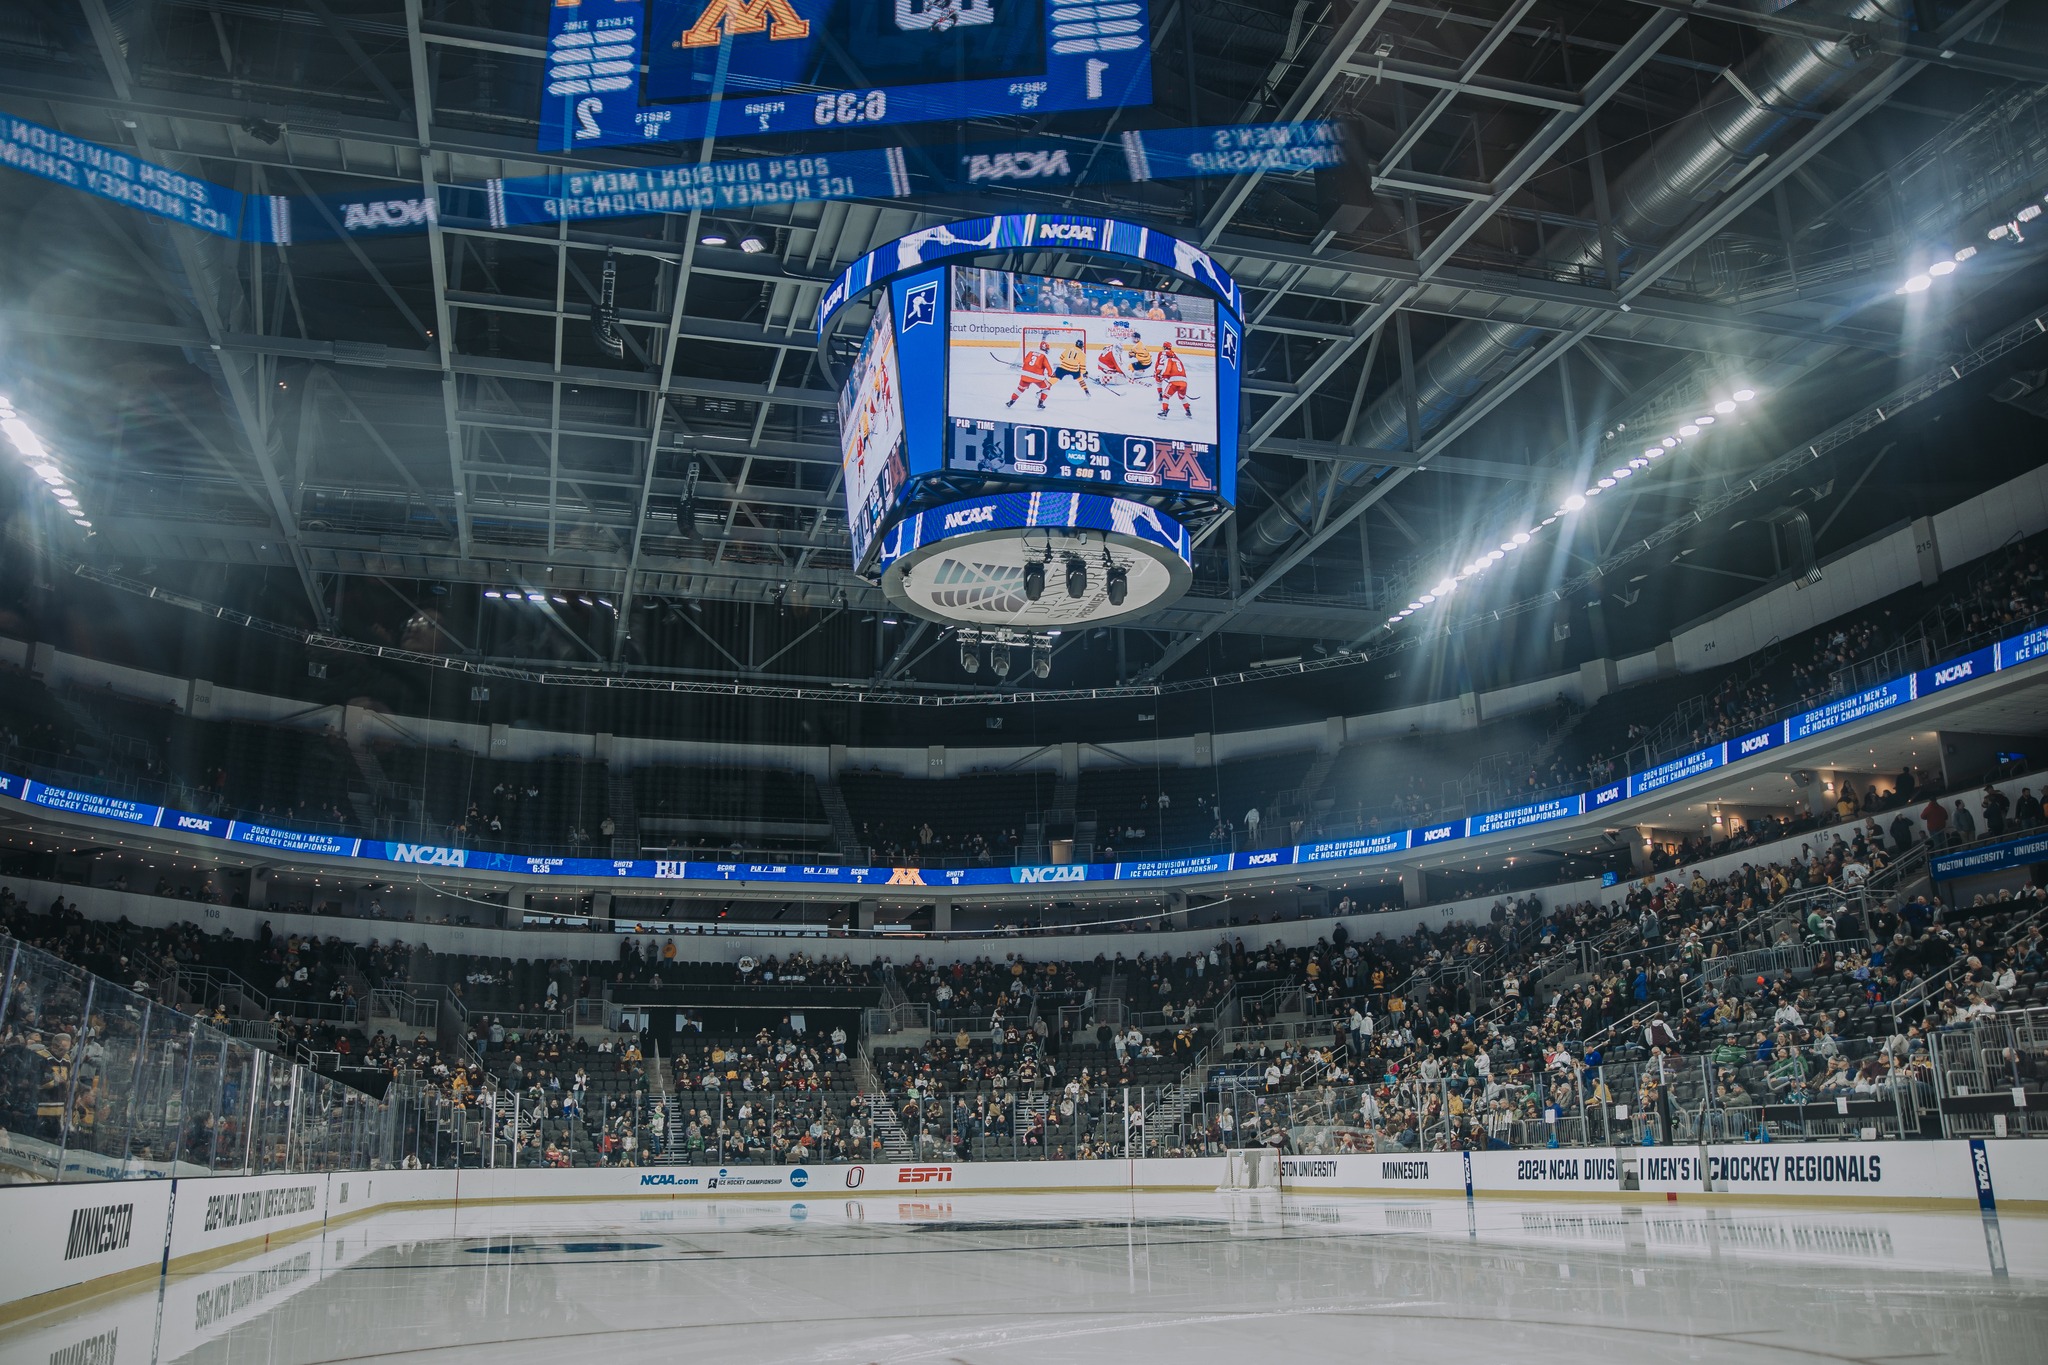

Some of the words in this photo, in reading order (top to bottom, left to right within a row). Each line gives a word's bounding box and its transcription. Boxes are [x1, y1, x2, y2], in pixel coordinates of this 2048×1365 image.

[1040, 224, 1094, 241] NCAA
[969, 323, 1023, 335] Orthopaedic
[956, 418, 970, 428] PLR
[976, 420, 995, 431] TIME
[1024, 433, 1036, 456] 1
[1058, 429, 1100, 453] 6:35
[1172, 441, 1185, 450] PLR
[1191, 443, 1209, 453] TIME
[1067, 453, 1086, 461] NCAA
[1089, 455, 1110, 467] 2ND
[1133, 444, 1147, 467] 2
[1017, 463, 1044, 472] TERRIERS
[1059, 466, 1071, 477] 15
[1099, 469, 1111, 480] 10
[1127, 475, 1153, 483] GOPHERS
[944, 506, 994, 530] NCAA
[1075, 592, 1109, 618] PREMIER
[1704, 640, 1715, 652] 214
[2015, 646, 2031, 662] ICE
[1935, 662, 1972, 686] NCAA
[1805, 709, 1823, 724] 2024
[1825, 700, 1857, 716] DIVISION
[1863, 686, 1888, 703] MEN'S
[1799, 724, 1810, 736] ICE
[1812, 714, 1839, 732] HOCKEY
[1840, 694, 1898, 722] CHAMPIONSHIP
[1741, 733, 1769, 754] NCAA
[1643, 771, 1658, 782] 2024
[1658, 762, 1683, 776] DIVISION
[1687, 752, 1706, 767] MEN'S
[1638, 781, 1648, 792] ICE
[1648, 774, 1669, 789] HOCKEY
[1670, 759, 1713, 781] CHAMPIONSHIP
[44, 787, 65, 798] 2024
[67, 792, 103, 805] DIVISION
[111, 799, 136, 811] MEN'S
[1596, 788, 1618, 804] NCAA
[36, 794, 47, 804] ICE
[48, 796, 81, 810] HOCKEY
[82, 803, 144, 821] CHAMPIONSHIP
[1485, 814, 1503, 823] 2024
[1504, 808, 1532, 820] DIVISION
[1538, 801, 1560, 812] MEN'S
[178, 816, 210, 831] NCAA
[1479, 823, 1490, 833] ICE
[1491, 818, 1516, 830] HOCKEY
[1517, 807, 1568, 825] CHAMPIONSHIP
[251, 826, 269, 835] 2024
[270, 829, 302, 841] DIVISION
[308, 835, 333, 845] MEN'S
[1424, 827, 1450, 841] NCAA
[1814, 831, 1829, 843] 115
[242, 832, 254, 841] ICE
[255, 834, 282, 846] HOCKEY
[282, 840, 341, 853] CHAMPIONSHIP
[1315, 843, 1333, 852] 2024
[1335, 839, 1365, 850] DIVISION
[1371, 836, 1391, 845] MEN'S
[1320, 849, 1347, 859] HOCKEY
[1348, 842, 1398, 856] CHAMPIONSHIP
[393, 843, 464, 867] NCAA
[527, 857, 544, 865] GAME
[544, 858, 563, 866] CLOCK
[1157, 860, 1185, 869] DIVISION
[1191, 857, 1211, 866] MEN'S
[1249, 853, 1277, 865] NCAA
[1937, 858, 1963, 873] BOSTON
[1964, 850, 2005, 868] UNIVERSITY
[532, 864, 550, 873] 6:35
[613, 861, 633, 869] SHOTS
[617, 868, 626, 876] 15
[654, 860, 687, 879] BU
[717, 864, 737, 872] SCORE
[750, 865, 762, 873] PLR
[803, 867, 816, 875] PLR
[850, 868, 869, 876] SCORE
[1130, 870, 1141, 878] ICE
[1142, 869, 1169, 878] HOCKEY
[1170, 864, 1218, 876] CHAMPIONSHIP
[724, 872, 729, 880] 1
[857, 875, 863, 884] 2
[946, 870, 964, 878] SHOTS
[950, 877, 959, 885] 10
[1020, 866, 1085, 883] NCAA
[204, 908, 220, 919] 108
[1441, 907, 1454, 917] 113
[898, 1167, 953, 1183] ESPN
[1299, 1161, 1338, 1177] UNIVERSITY
[1382, 1161, 1429, 1180] MINNESOTA
[1518, 1159, 1547, 1181] 2024
[1549, 1159, 1579, 1181] NCAA
[1640, 1157, 1644, 1181] I
[1647, 1157, 1690, 1181] MEN'S
[1784, 1155, 1881, 1182] REGIONALS
[1973, 1148, 1990, 1190] NCAA
[640, 1175, 699, 1186] NCAA.com
[64, 1203, 134, 1261] MINNESOTA
